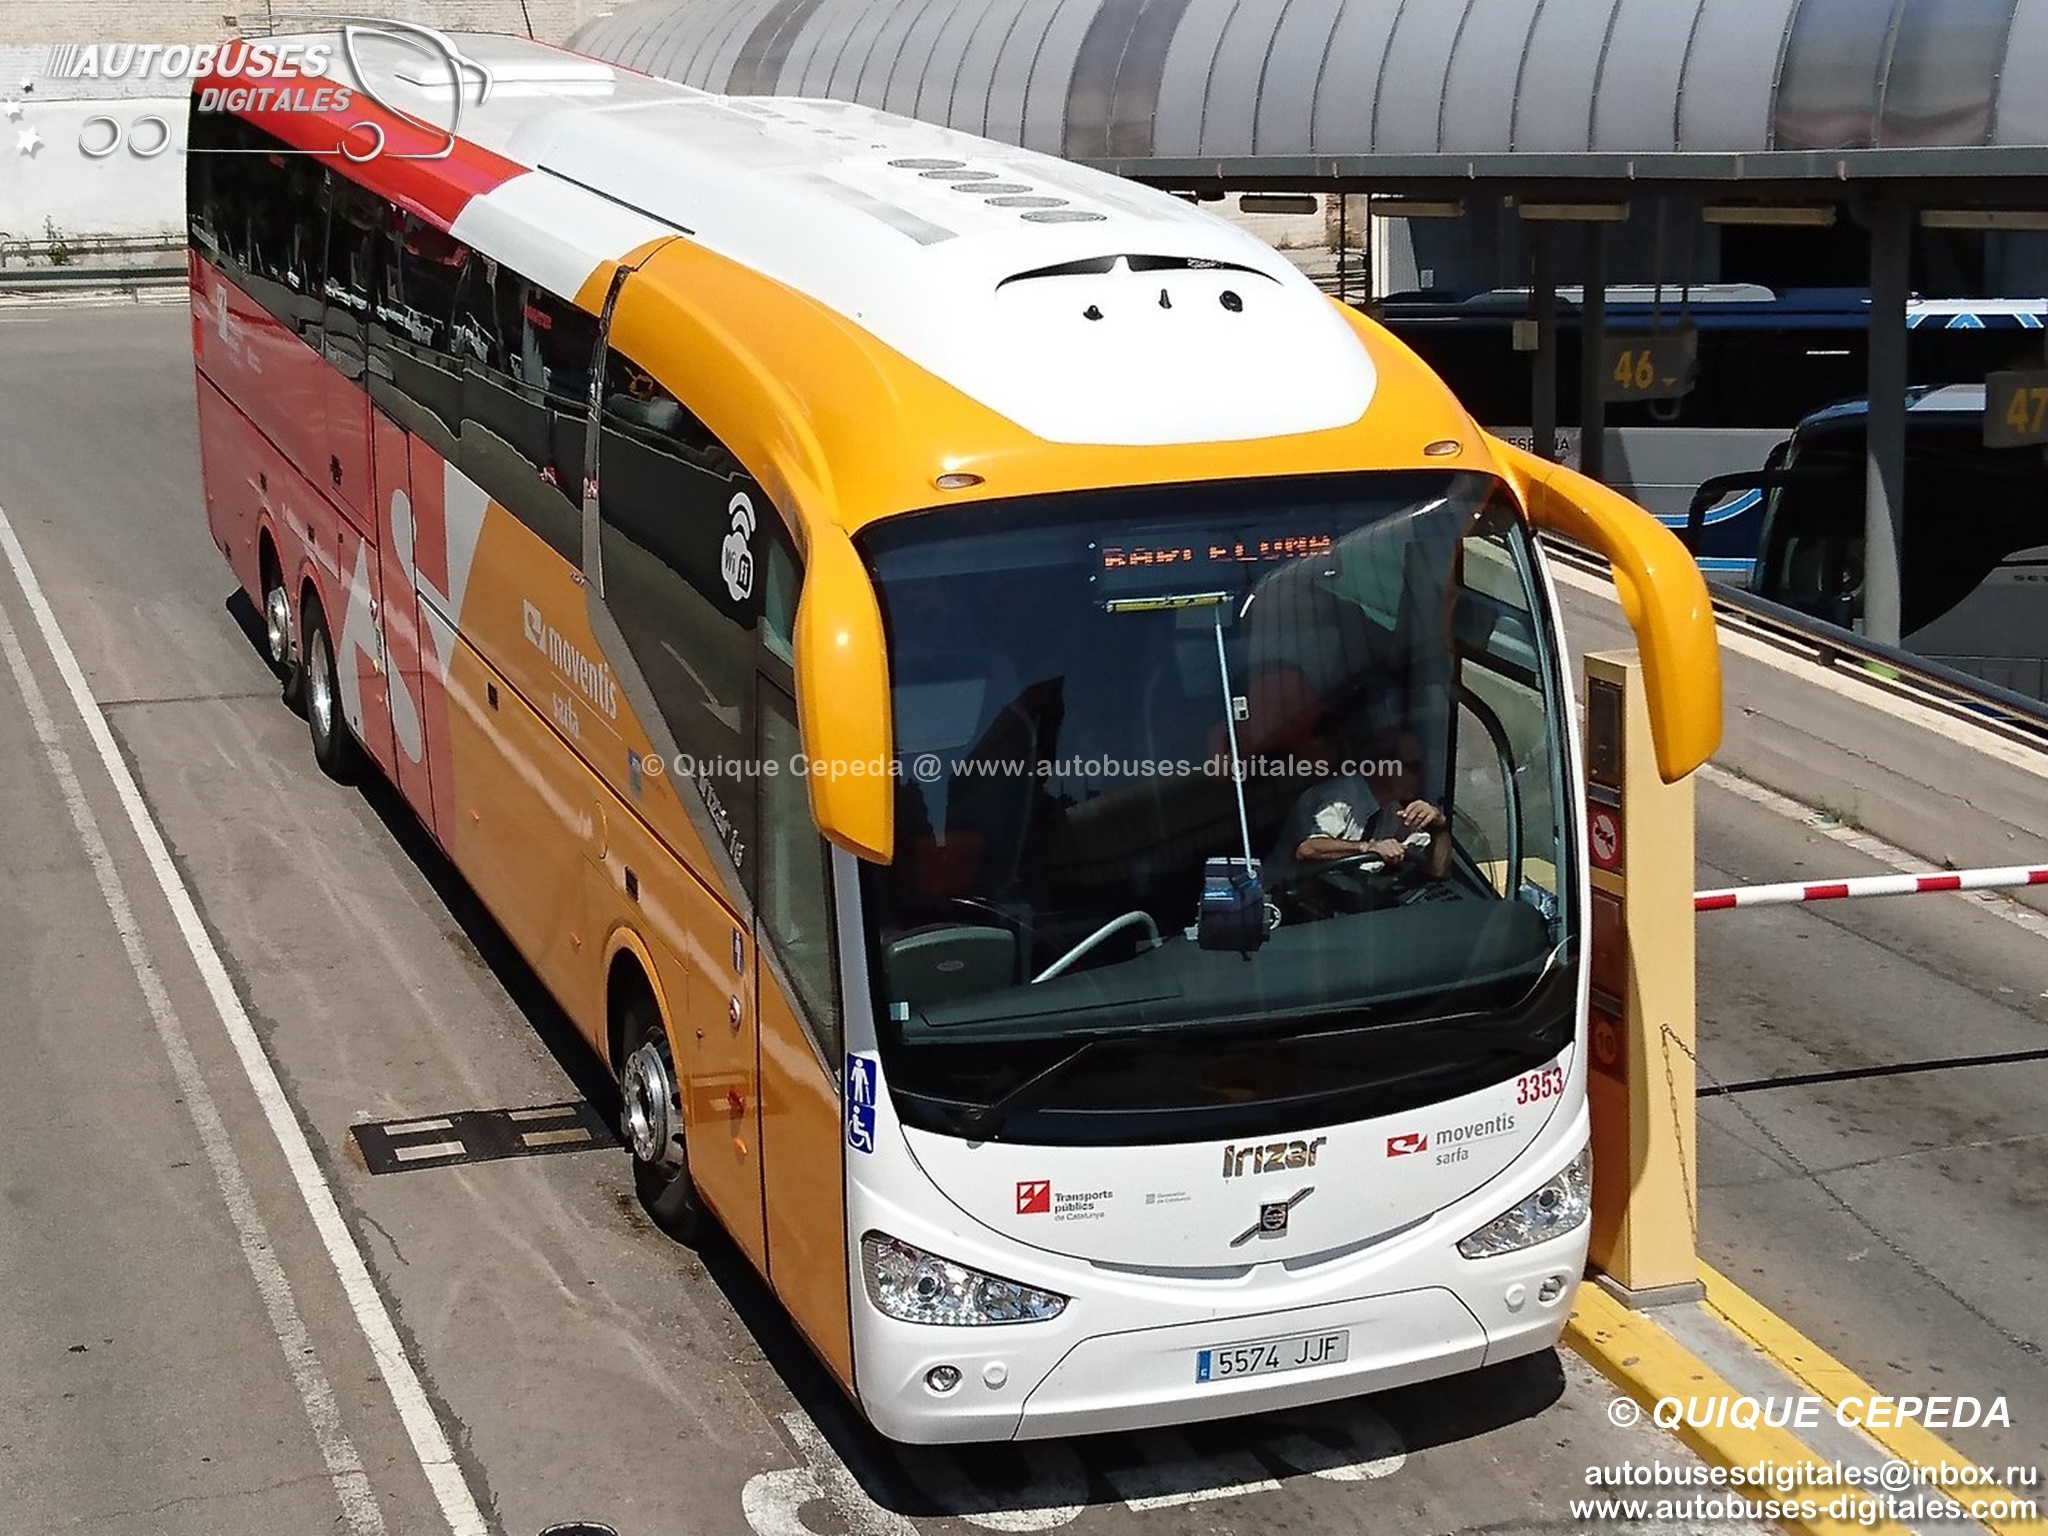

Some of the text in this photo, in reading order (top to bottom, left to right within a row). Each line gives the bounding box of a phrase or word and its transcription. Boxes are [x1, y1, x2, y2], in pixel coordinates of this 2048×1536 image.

[1612, 349, 1654, 389] 46
[2006, 387, 2048, 434] 47
[549, 627, 617, 720] moventis
[1516, 1066, 1563, 1105] 3353
[1435, 1112, 1515, 1146] moventis
[1435, 1148, 1470, 1167] sarfa
[1054, 1189, 1113, 1203] Transports
[1054, 1202, 1095, 1214] públics
[1219, 1345, 1280, 1374] 5574
[1295, 1336, 1339, 1365] JJF
